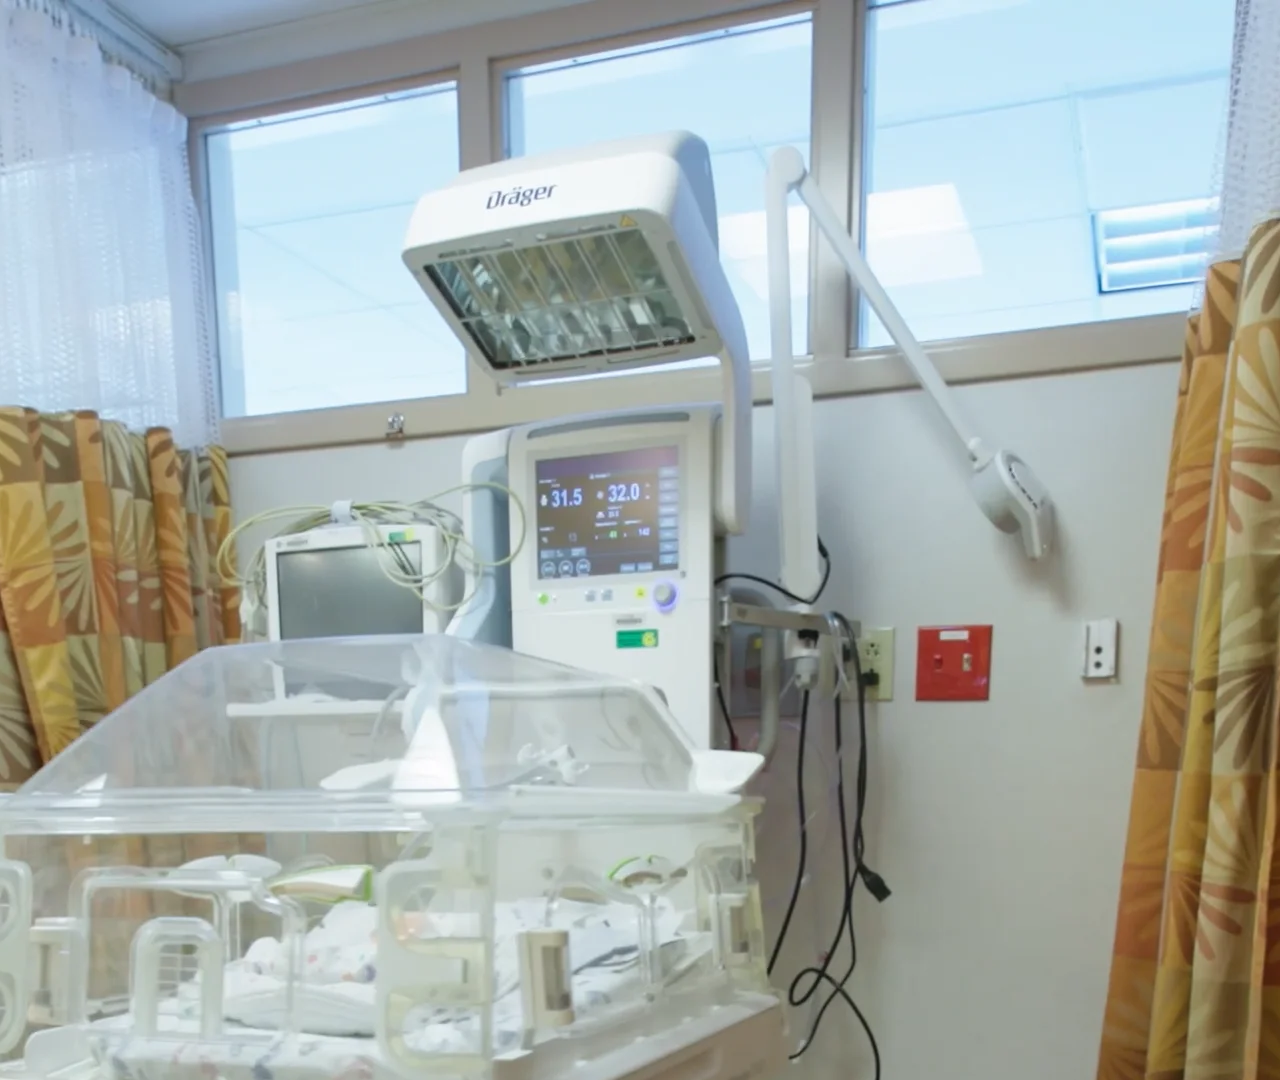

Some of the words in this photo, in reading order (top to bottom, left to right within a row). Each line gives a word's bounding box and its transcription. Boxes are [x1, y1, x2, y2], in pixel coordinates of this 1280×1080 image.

[486, 184, 557, 209] Dräger
[551, 487, 583, 508] 31.5
[607, 482, 640, 502] 32.0
